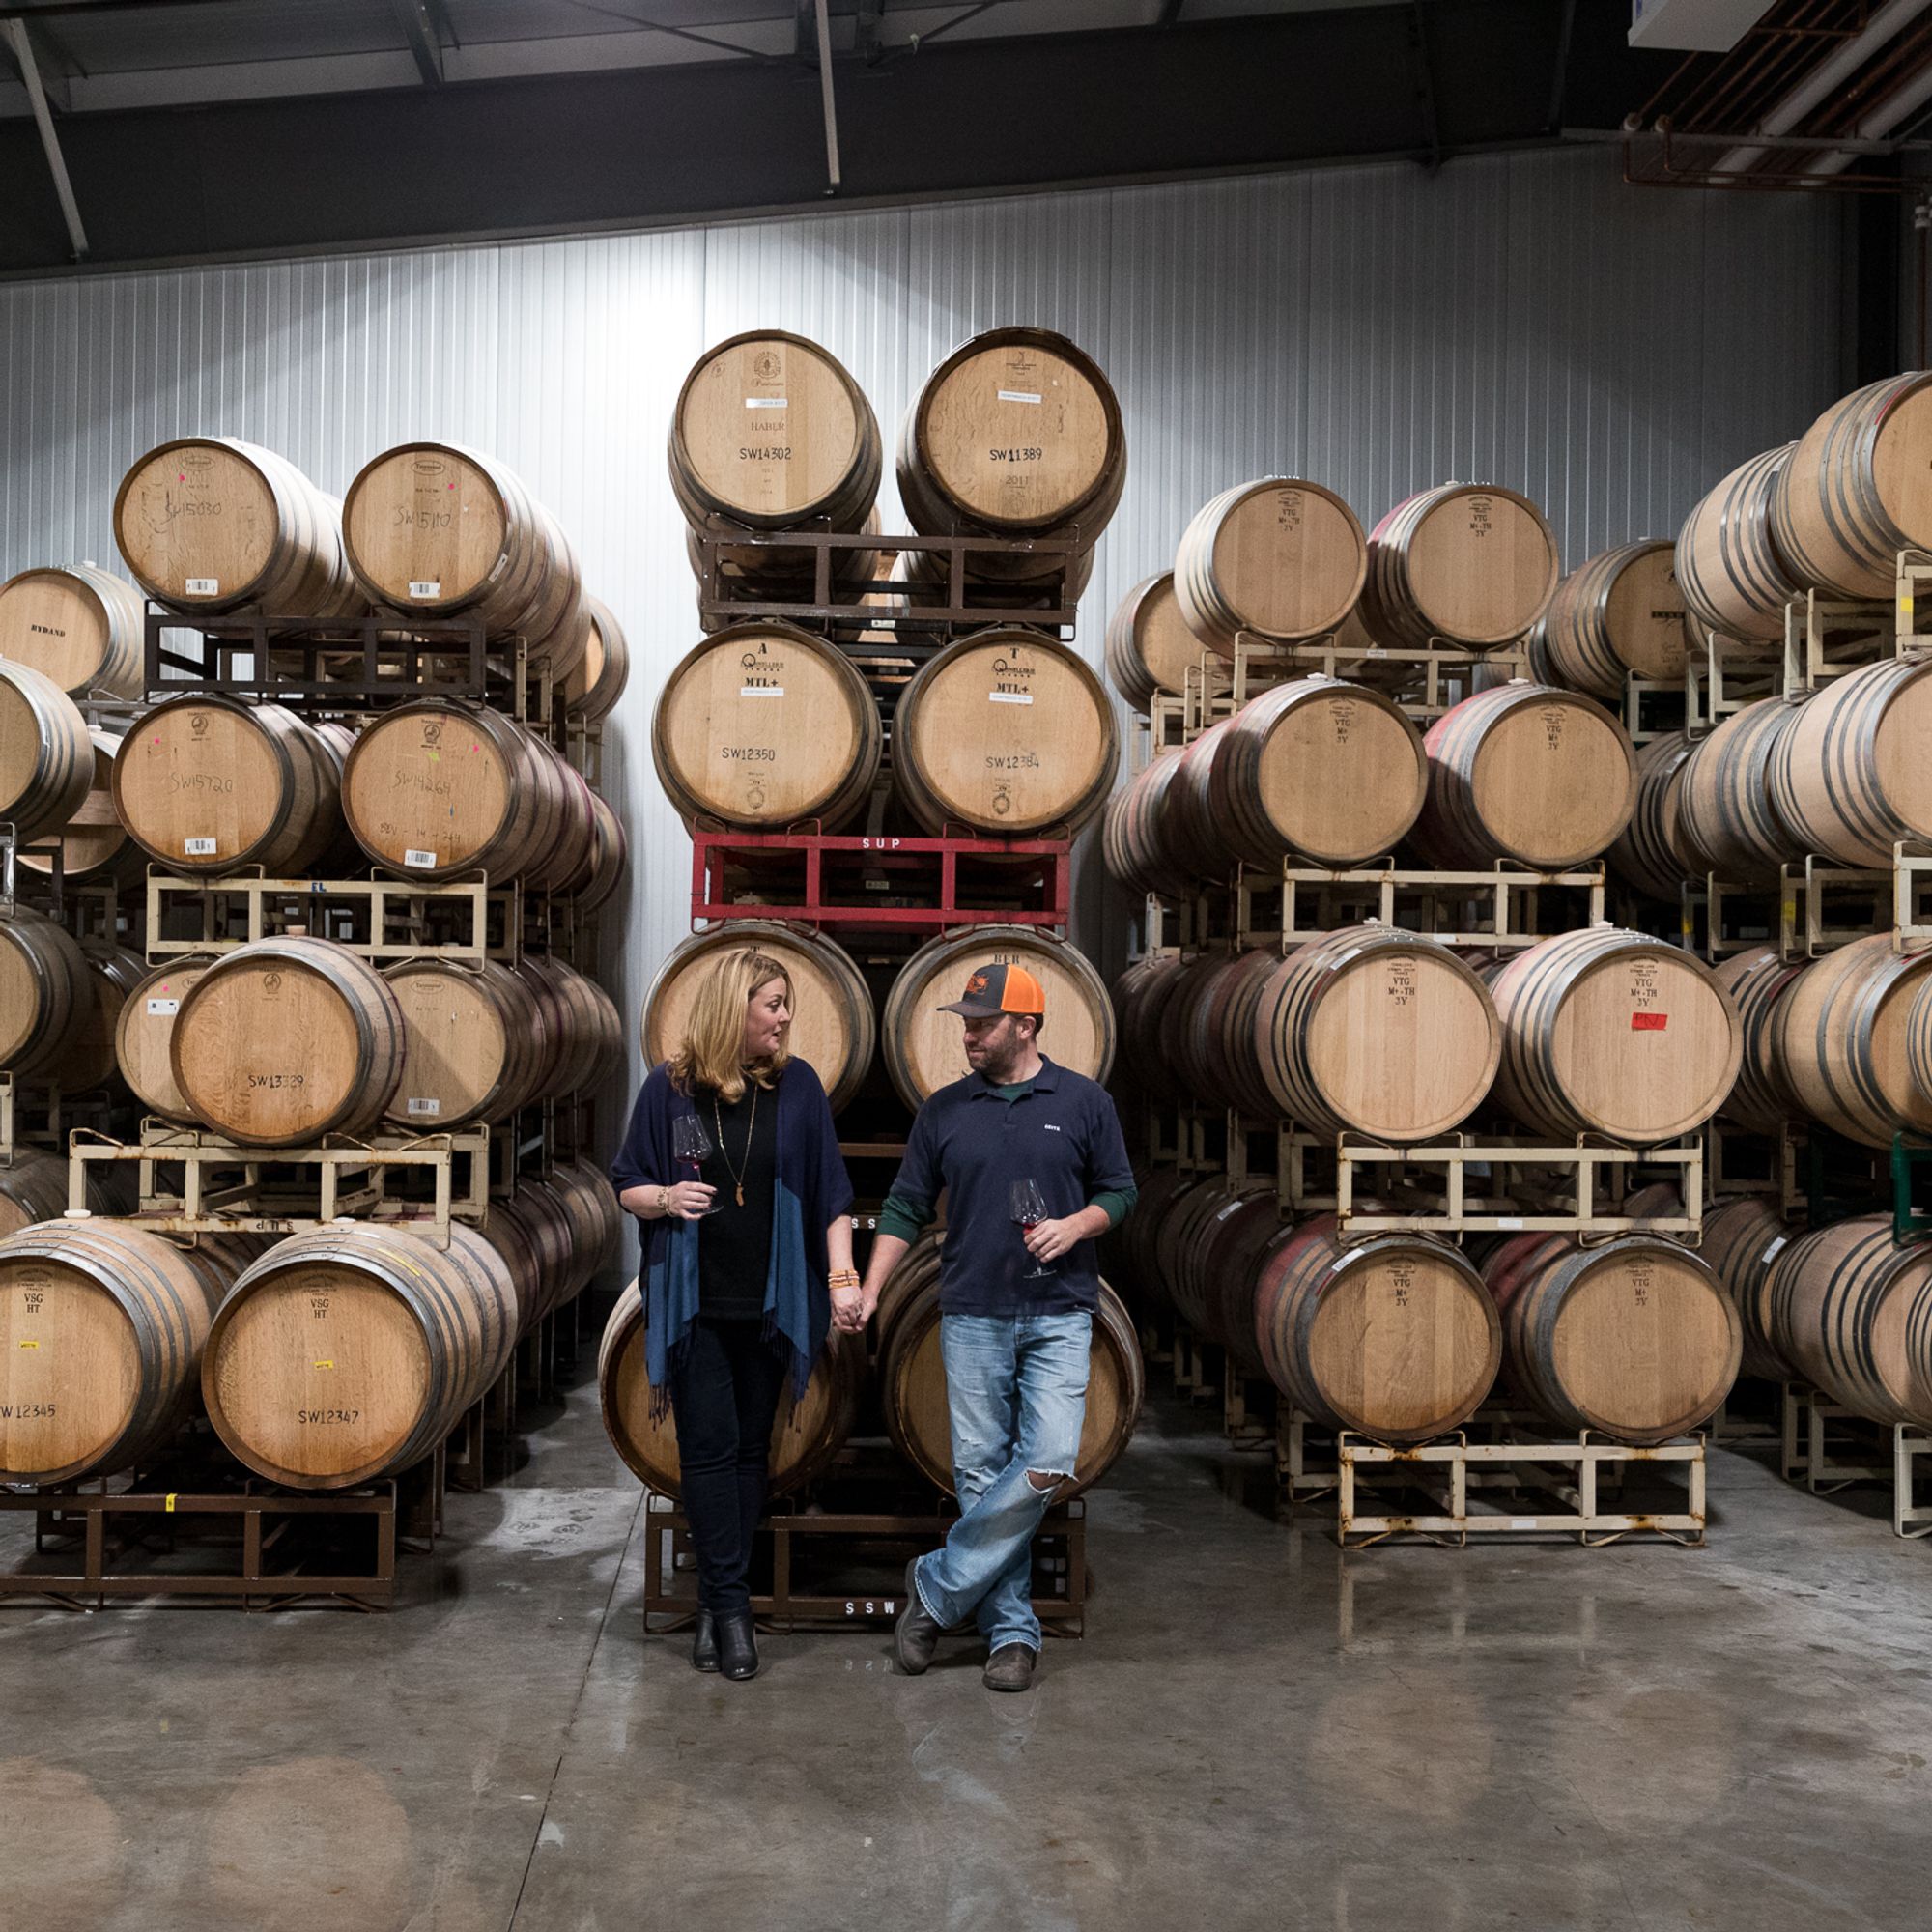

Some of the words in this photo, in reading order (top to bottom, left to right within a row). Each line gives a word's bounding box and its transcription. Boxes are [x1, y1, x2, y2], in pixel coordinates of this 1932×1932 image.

[740, 447, 792, 461] SW14302
[989, 447, 1043, 462] SW11389
[757, 642, 767, 655] A
[1009, 647, 1020, 659] T
[722, 747, 776, 761] SW12350
[1393, 977, 1410, 985] VTG
[1634, 979, 1653, 987] VTG
[24, 1293, 43, 1304] VSG
[310, 1298, 329, 1309] VSG
[27, 1304, 41, 1314] HT
[314, 1309, 327, 1319] HT
[0, 1404, 56, 1419] W12345
[298, 1410, 359, 1425] SW12347
